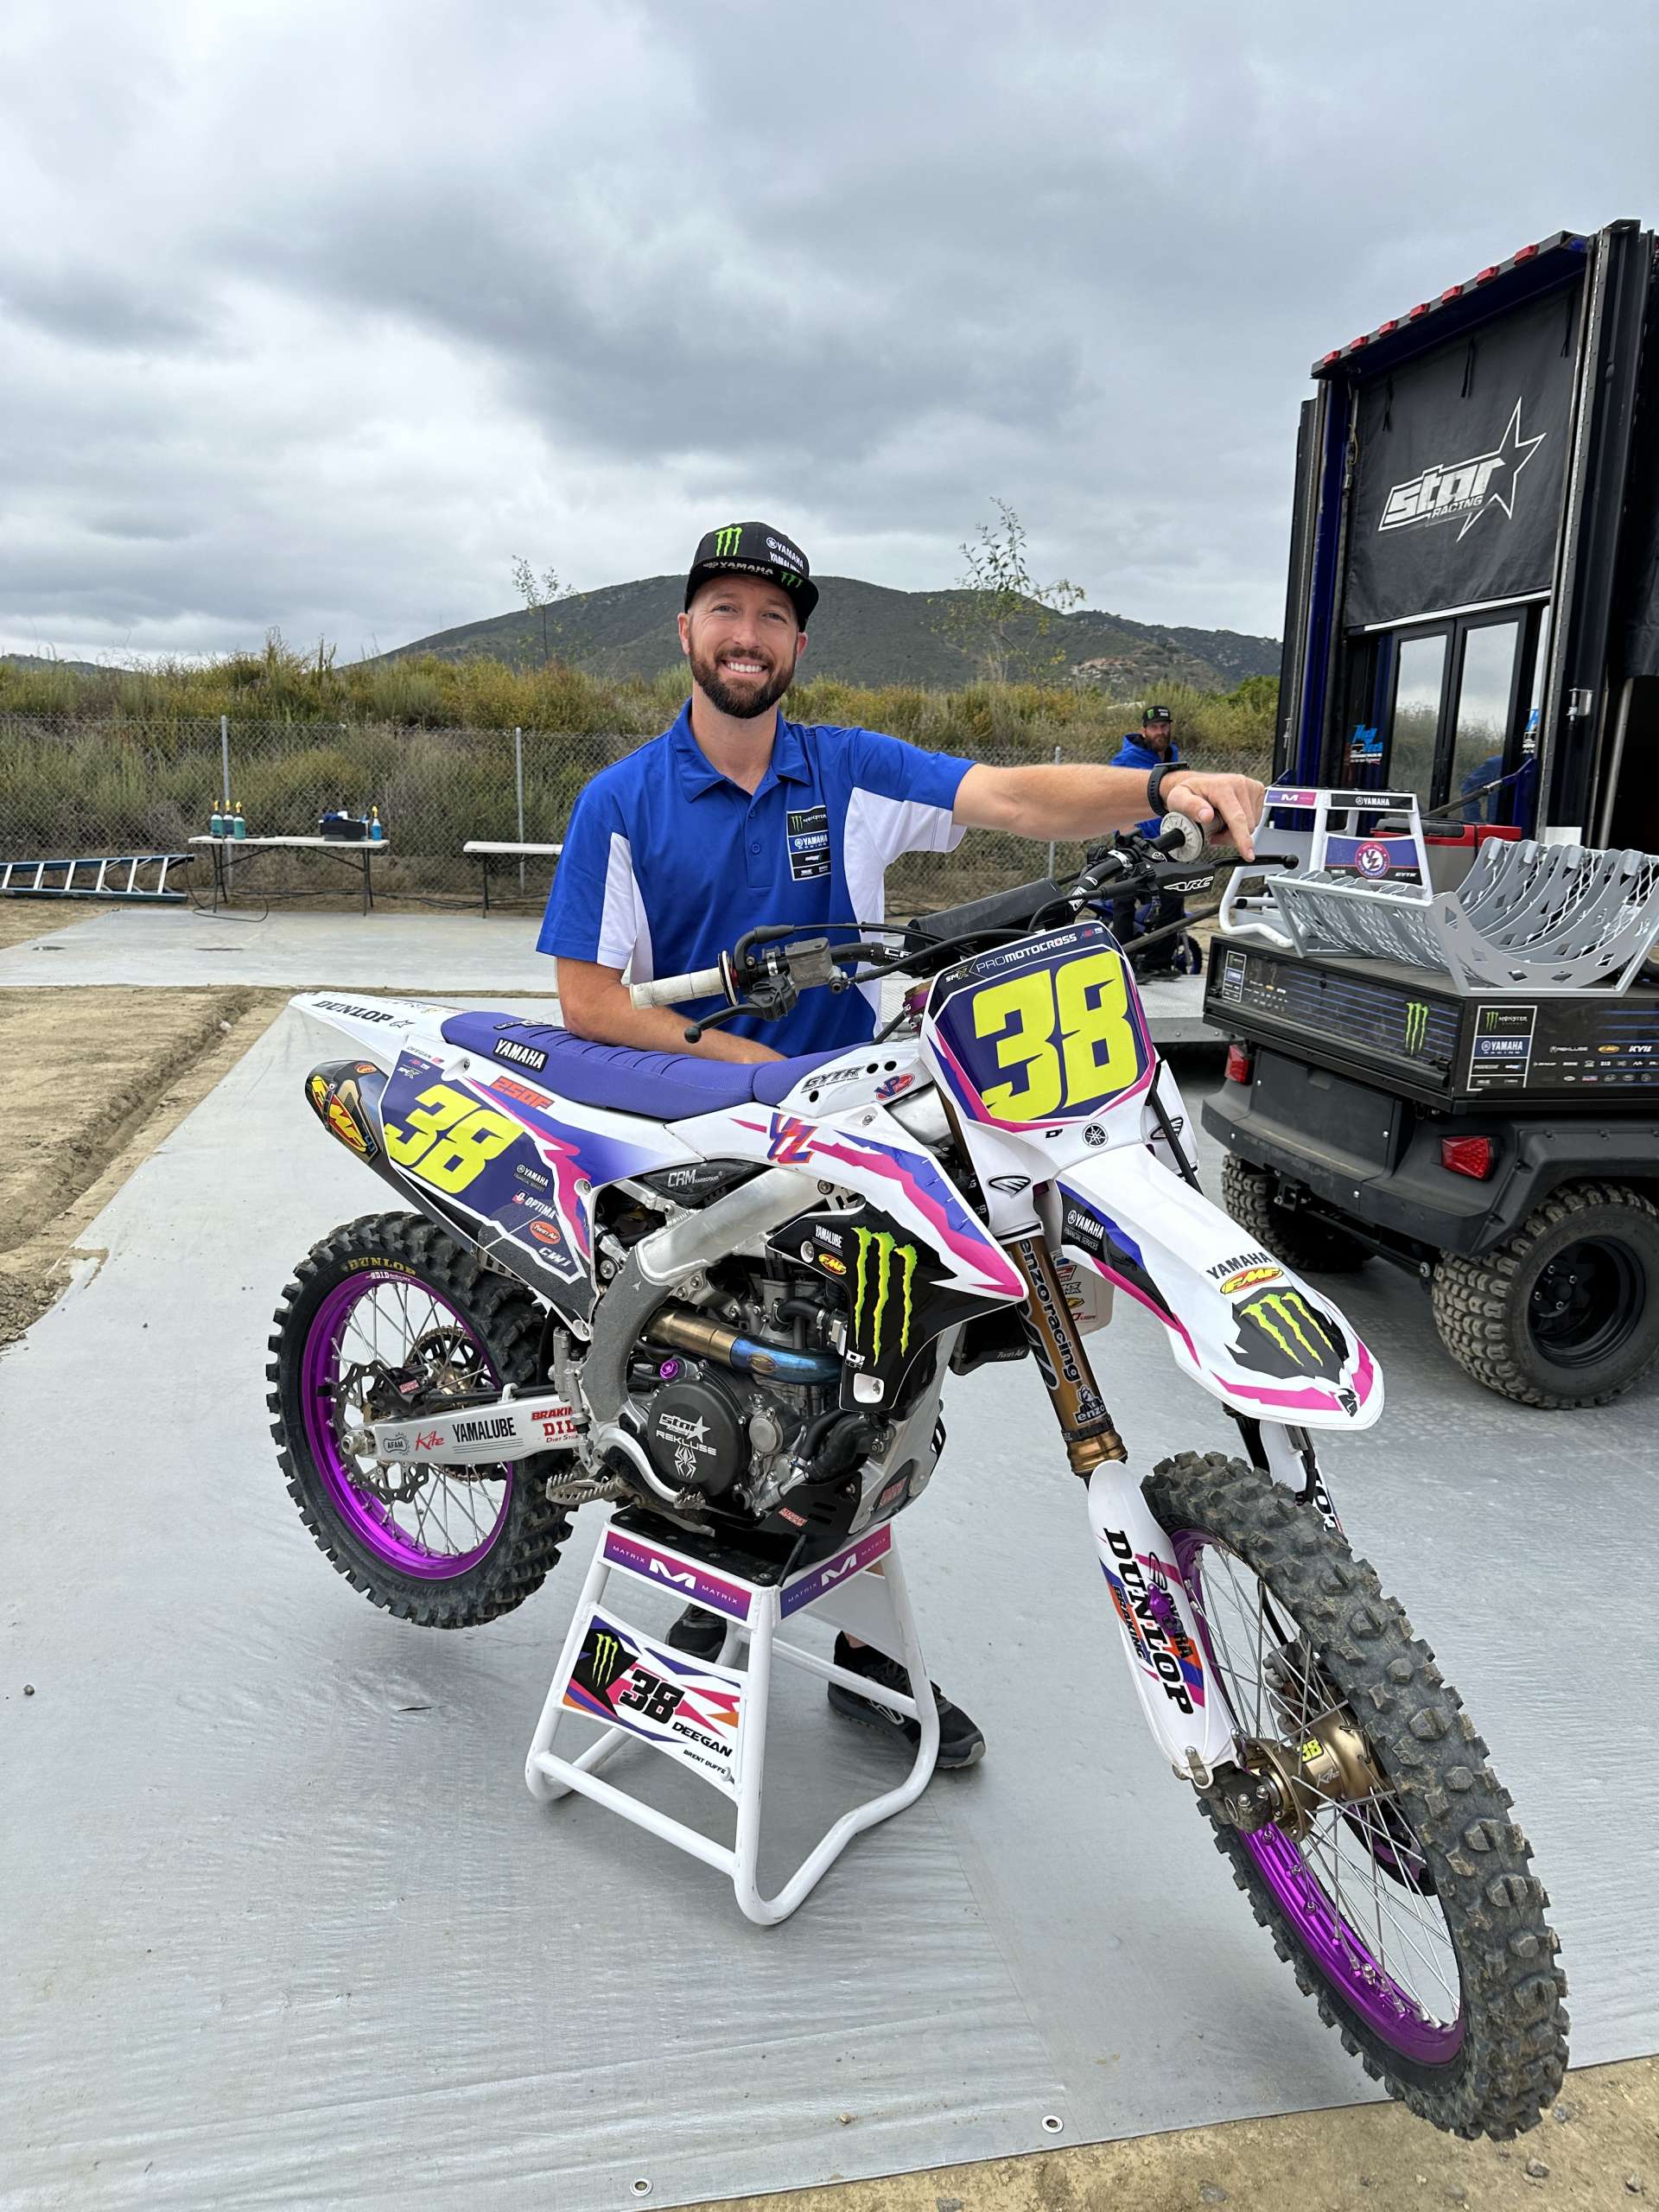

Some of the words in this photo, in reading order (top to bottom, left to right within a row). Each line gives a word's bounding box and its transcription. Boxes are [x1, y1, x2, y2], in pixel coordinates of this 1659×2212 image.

[1384, 457, 1506, 524] star
[1431, 495, 1484, 519] RACING
[720, 562, 773, 575] YAMAHA
[778, 542, 804, 570] YAMAHA
[1363, 797, 1390, 806] YAMAHA
[802, 834, 828, 846] YAMAHA
[311, 1000, 394, 1023] DUNLOP
[972, 950, 1138, 1122] 38
[1491, 1040, 1523, 1051] YAMAHA
[494, 1039, 546, 1069] YAMAHA
[490, 1076, 556, 1110] 250F
[384, 1084, 525, 1194] 38
[766, 1112, 818, 1164] YZ
[524, 1167, 549, 1187] YAMAHA
[525, 1197, 556, 1219] OPTIMA
[815, 1224, 842, 1249] YAMALUBE
[1076, 1213, 1104, 1239] YAMAHA
[348, 1256, 416, 1275] DUNLOP
[1206, 1252, 1273, 1280] YAMAHA
[1221, 1268, 1283, 1294] FMF
[531, 1406, 573, 1421] BRAKIN
[1077, 1404, 1105, 1421] enzo
[416, 1431, 445, 1452] Kite
[452, 1417, 517, 1443] YAMALUBE
[657, 1429, 717, 1456] REKLUSE
[387, 1441, 404, 1450] AFAM
[613, 1545, 645, 1564] MATRIX
[702, 1585, 739, 1605] MATRIX
[788, 1582, 817, 1603] MATRIX
[861, 1537, 887, 1556] MATRIX
[1103, 1527, 1194, 1714] DUNLOP
[619, 1668, 685, 1725] 38
[671, 1721, 734, 1758] DEEGAN
[683, 1749, 705, 1764] BRENT
